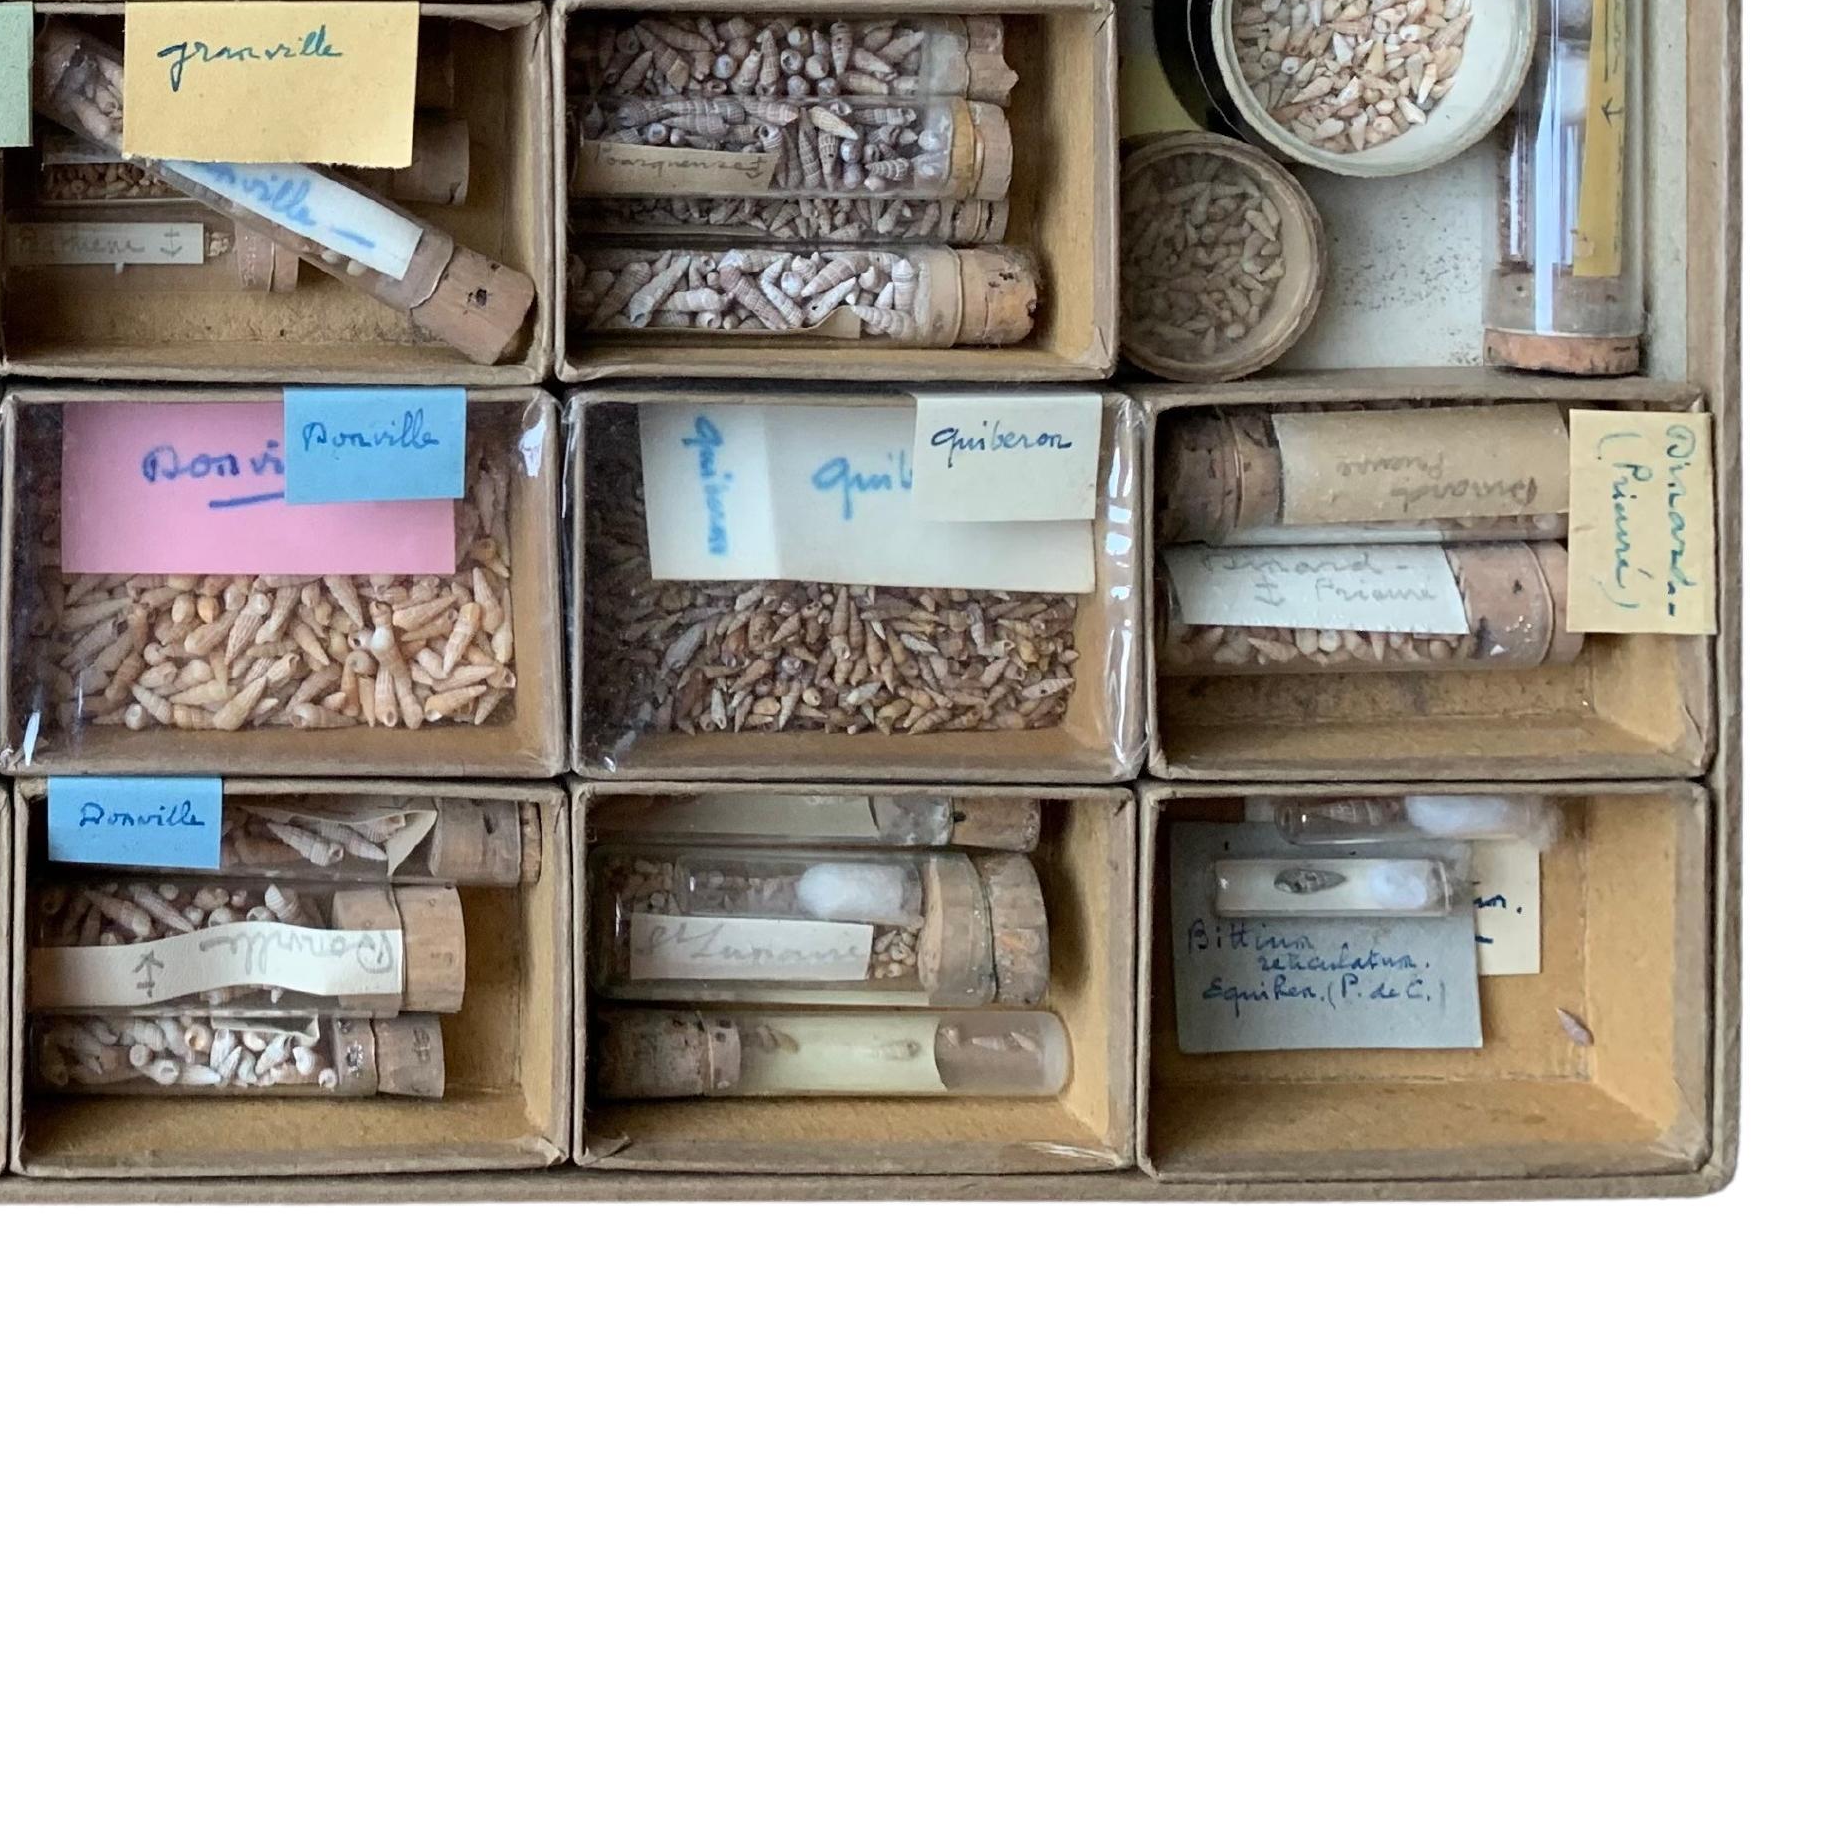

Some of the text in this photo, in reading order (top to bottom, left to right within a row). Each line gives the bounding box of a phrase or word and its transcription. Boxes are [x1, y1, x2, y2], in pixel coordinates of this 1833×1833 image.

[302, 408, 439, 452] Donville
[142, 440, 284, 485] Donvi
[77, 801, 206, 829] Donville
[1187, 918, 1315, 954] Bittium
